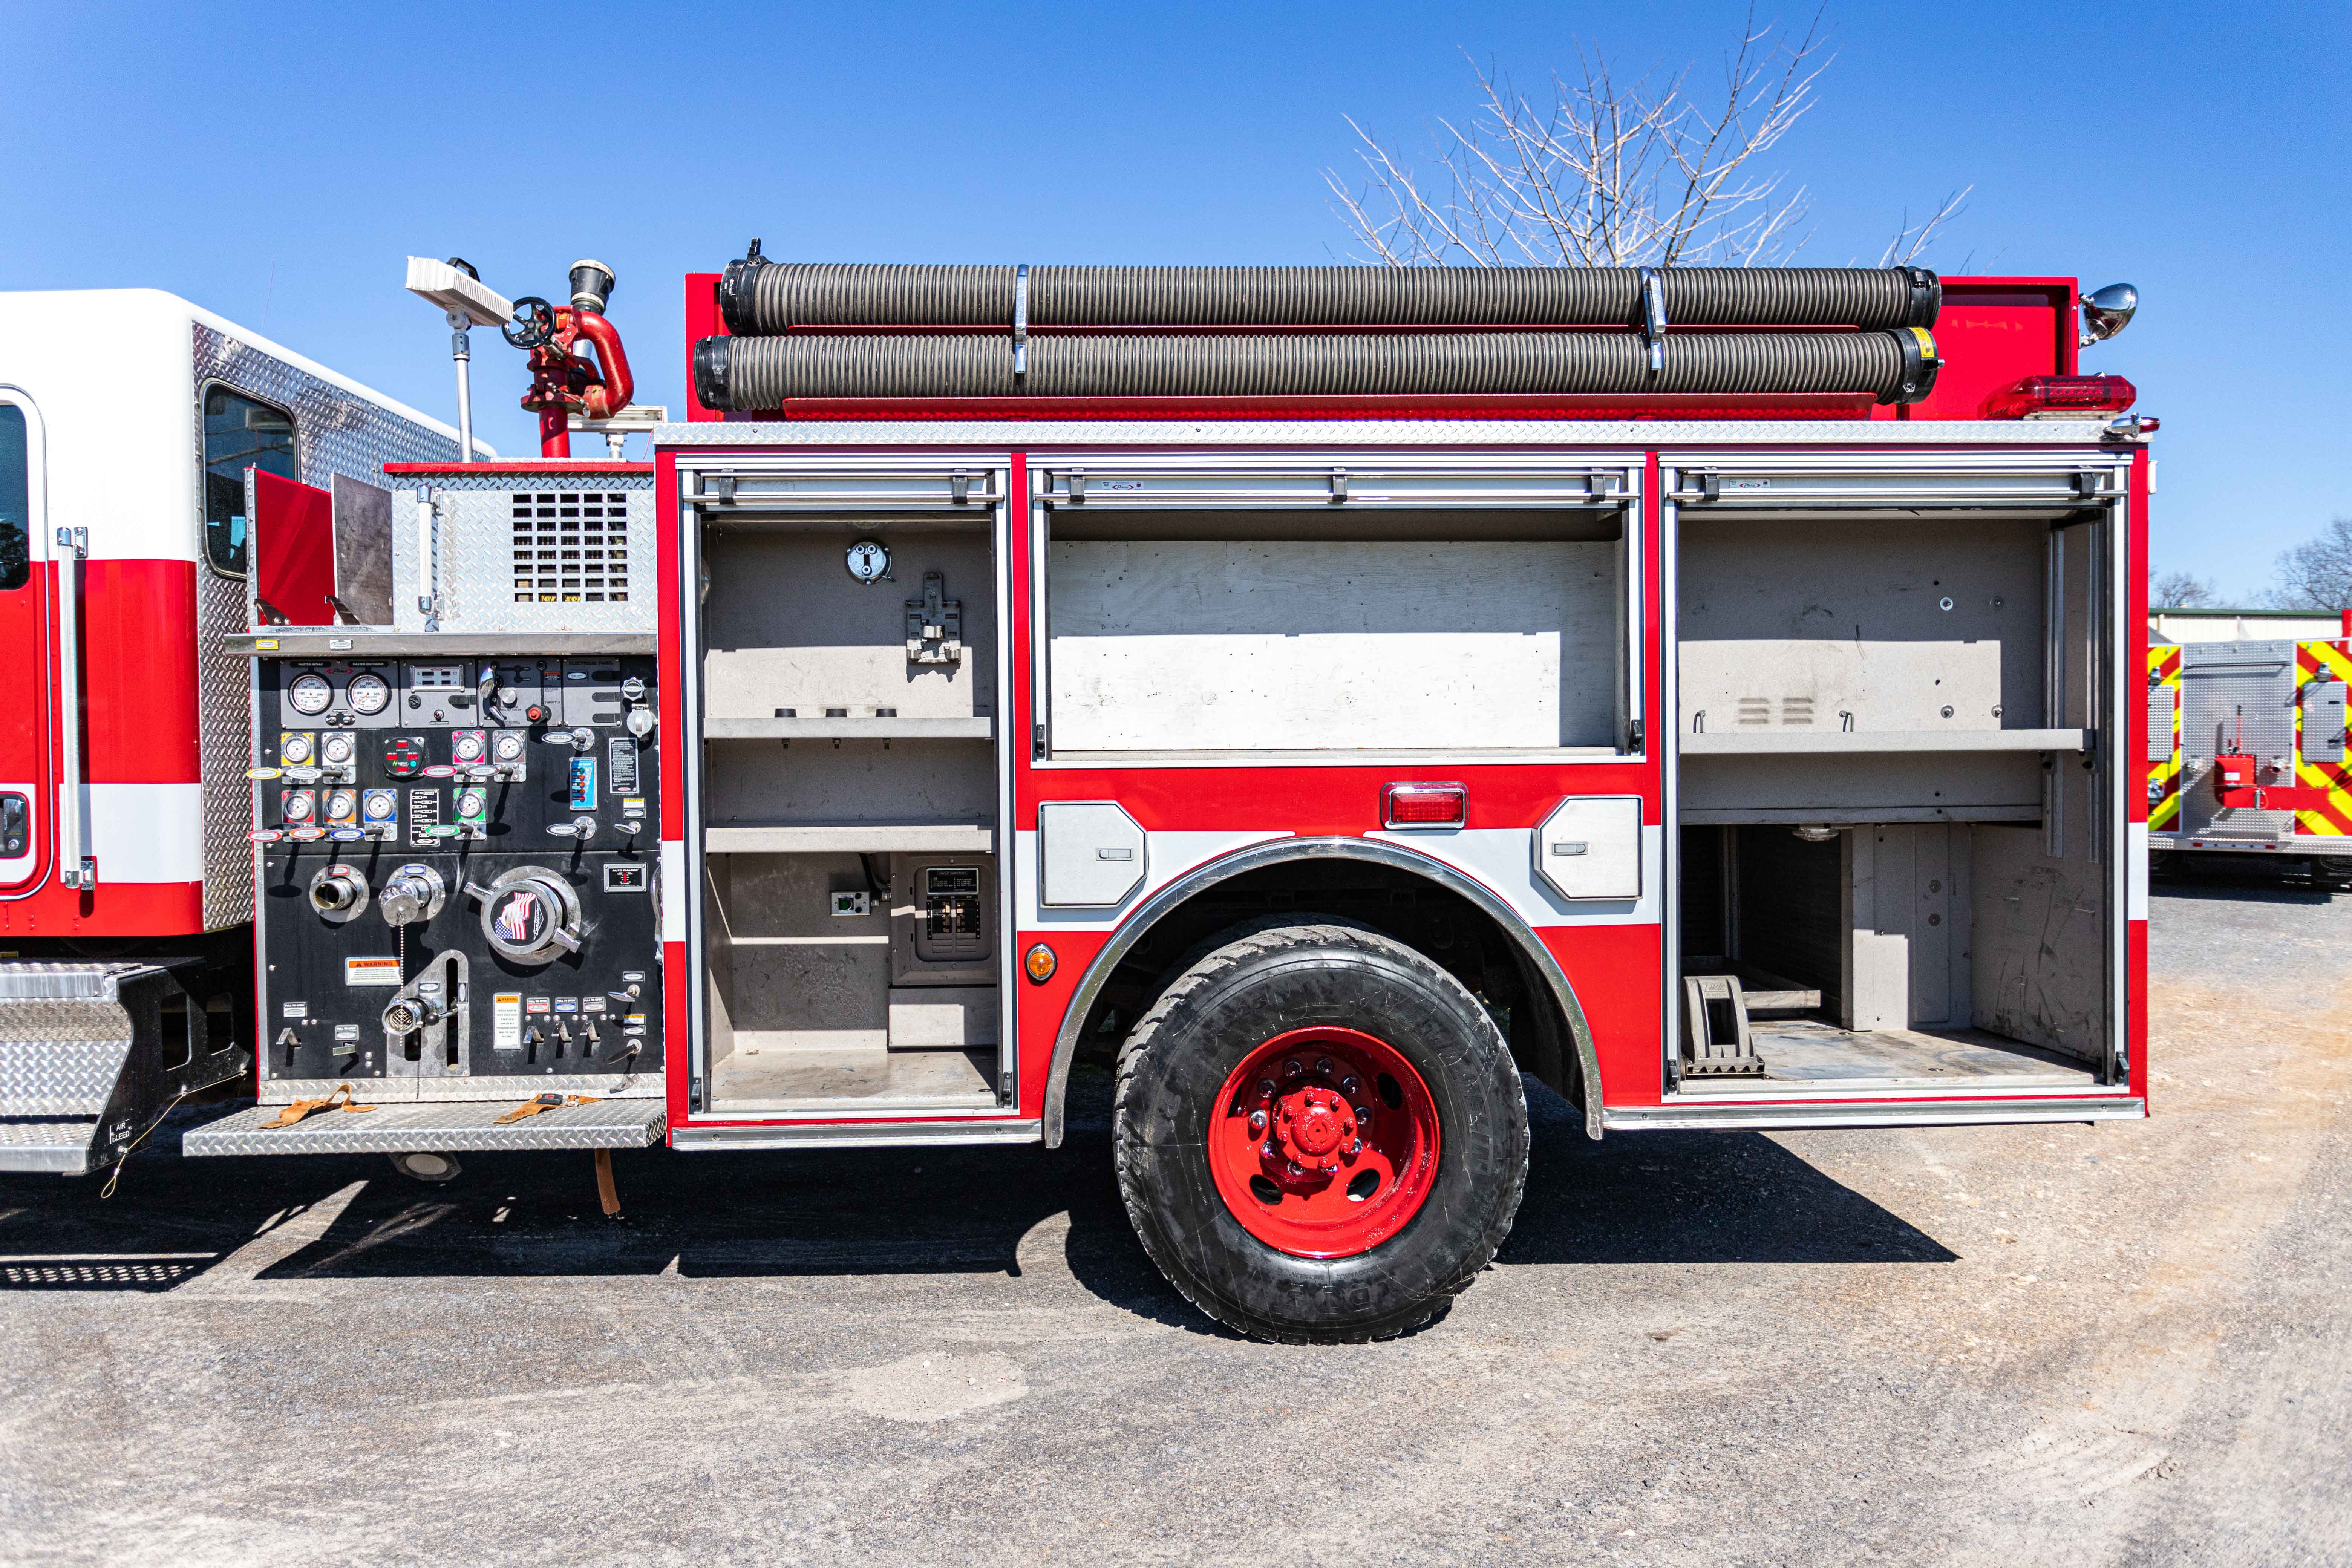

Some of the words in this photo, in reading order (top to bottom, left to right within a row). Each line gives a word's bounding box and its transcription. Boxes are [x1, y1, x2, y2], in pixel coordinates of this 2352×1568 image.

[116, 1122, 126, 1131] AIR
[112, 1131, 129, 1142] BLEED
[1291, 1272, 1324, 1280] MICHELIN
[1337, 1262, 1386, 1280] REGROOVABLE
